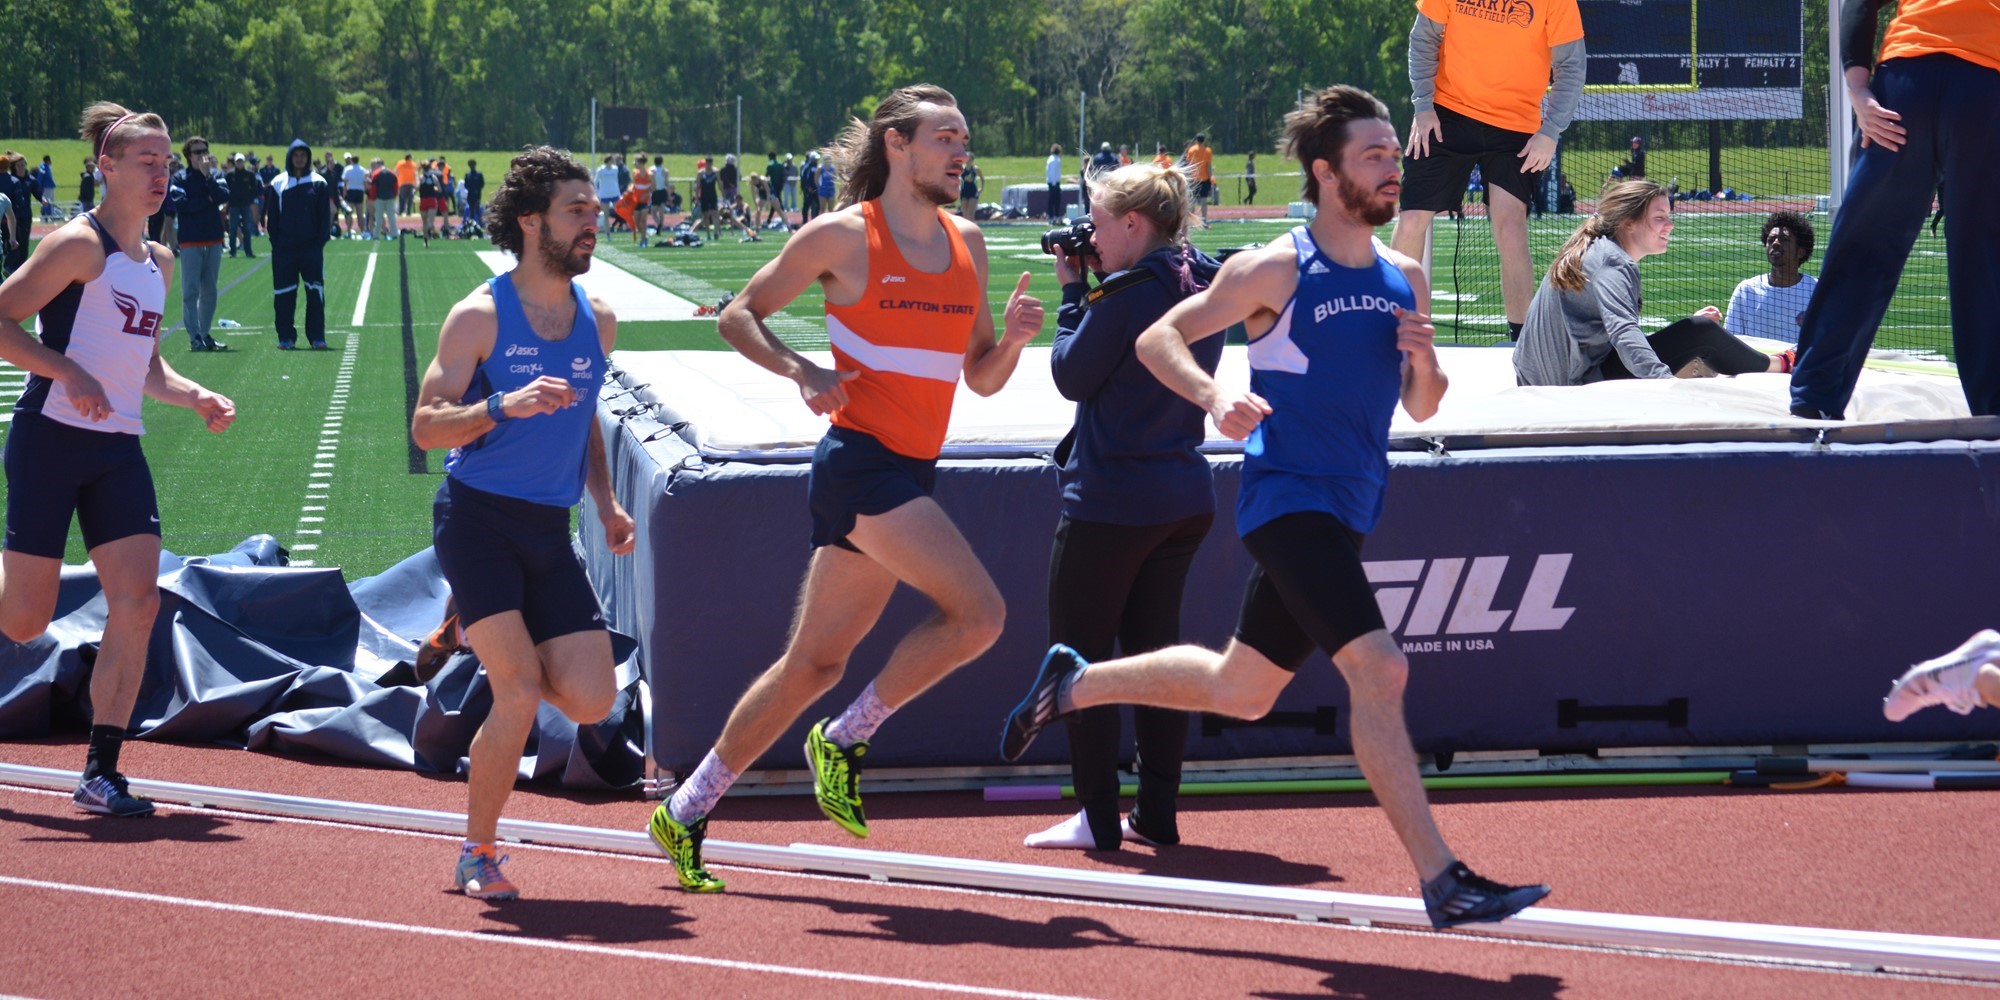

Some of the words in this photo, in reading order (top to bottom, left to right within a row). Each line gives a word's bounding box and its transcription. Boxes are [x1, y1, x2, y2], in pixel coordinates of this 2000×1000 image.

[1457, 0, 1511, 12] RRY
[1455, 4, 1478, 17] TRACK
[1484, 11, 1505, 23] FIELD
[1680, 58, 1720, 68] PEALTY
[1724, 58, 1730, 68] 1
[1744, 58, 1786, 68] PENALTY
[1789, 58, 1796, 68] 2
[880, 300, 939, 312] CLAYTON
[942, 304, 975, 315] STATE
[1361, 553, 1577, 636] GILL
[1403, 641, 1442, 653] MADE
[1446, 641, 1461, 651] IN
[1466, 639, 1494, 650] USA
